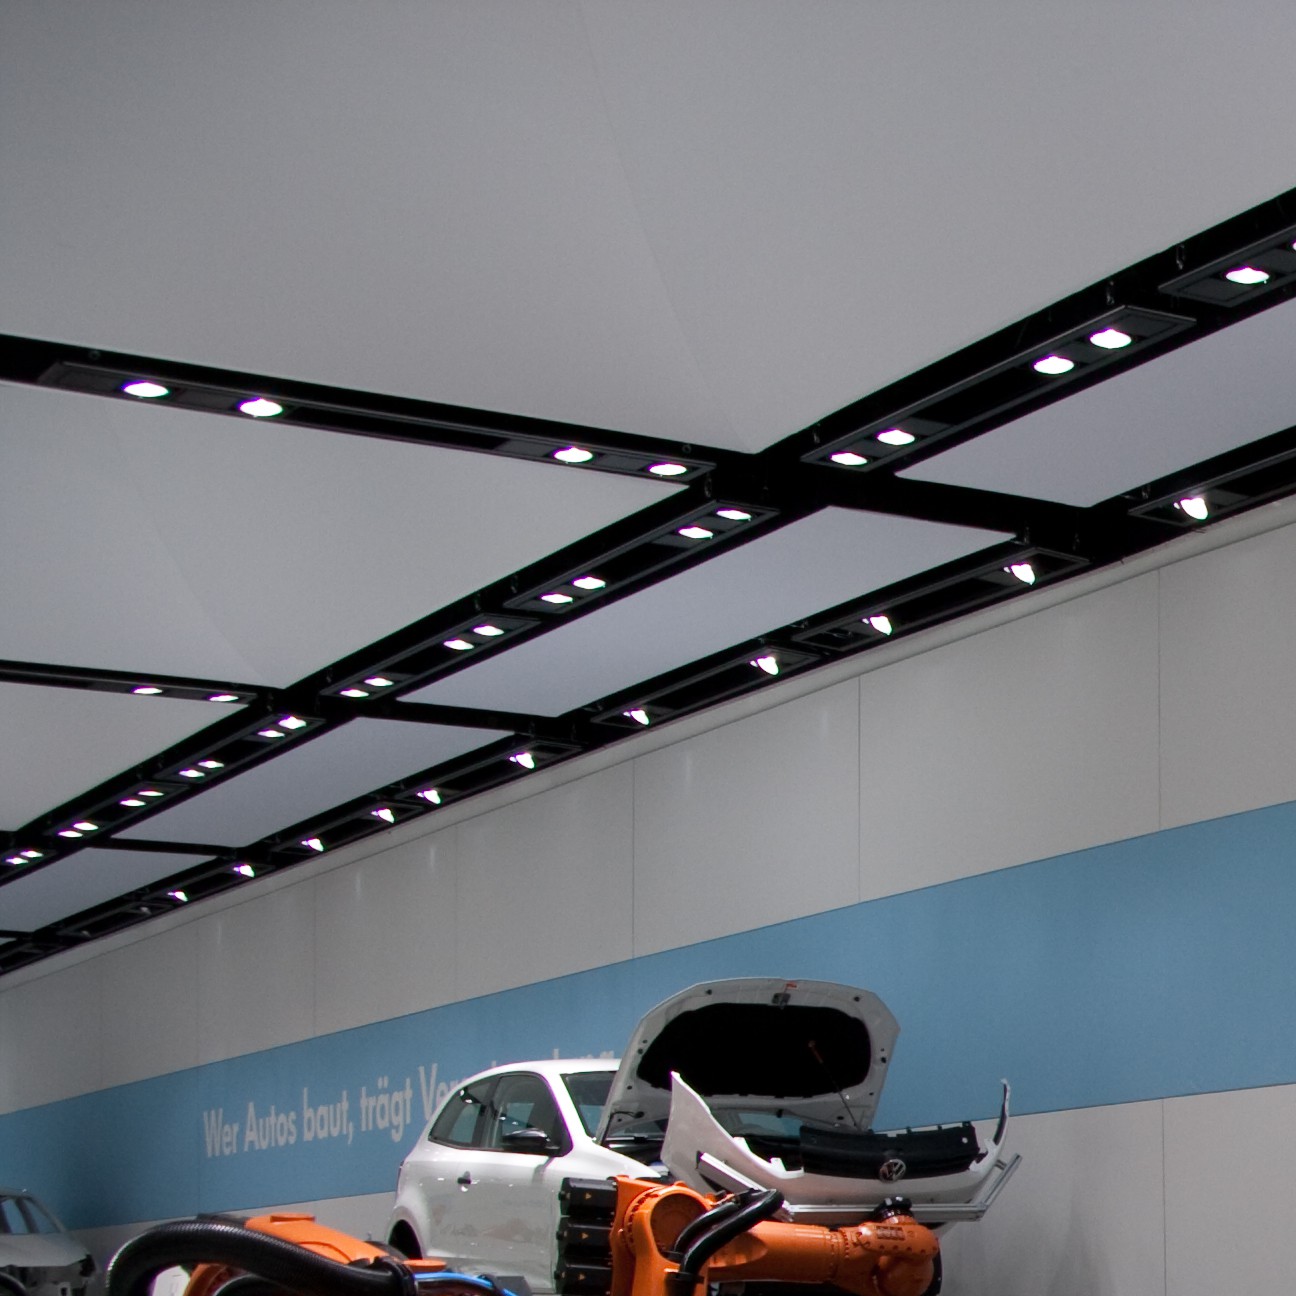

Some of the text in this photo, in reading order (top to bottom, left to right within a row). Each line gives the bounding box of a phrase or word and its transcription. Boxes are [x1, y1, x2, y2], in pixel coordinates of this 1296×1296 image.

[202, 1105, 238, 1159] Wer
[243, 1101, 297, 1152] Autos
[302, 1086, 354, 1145] baut,
[360, 1076, 413, 1144] trägt
